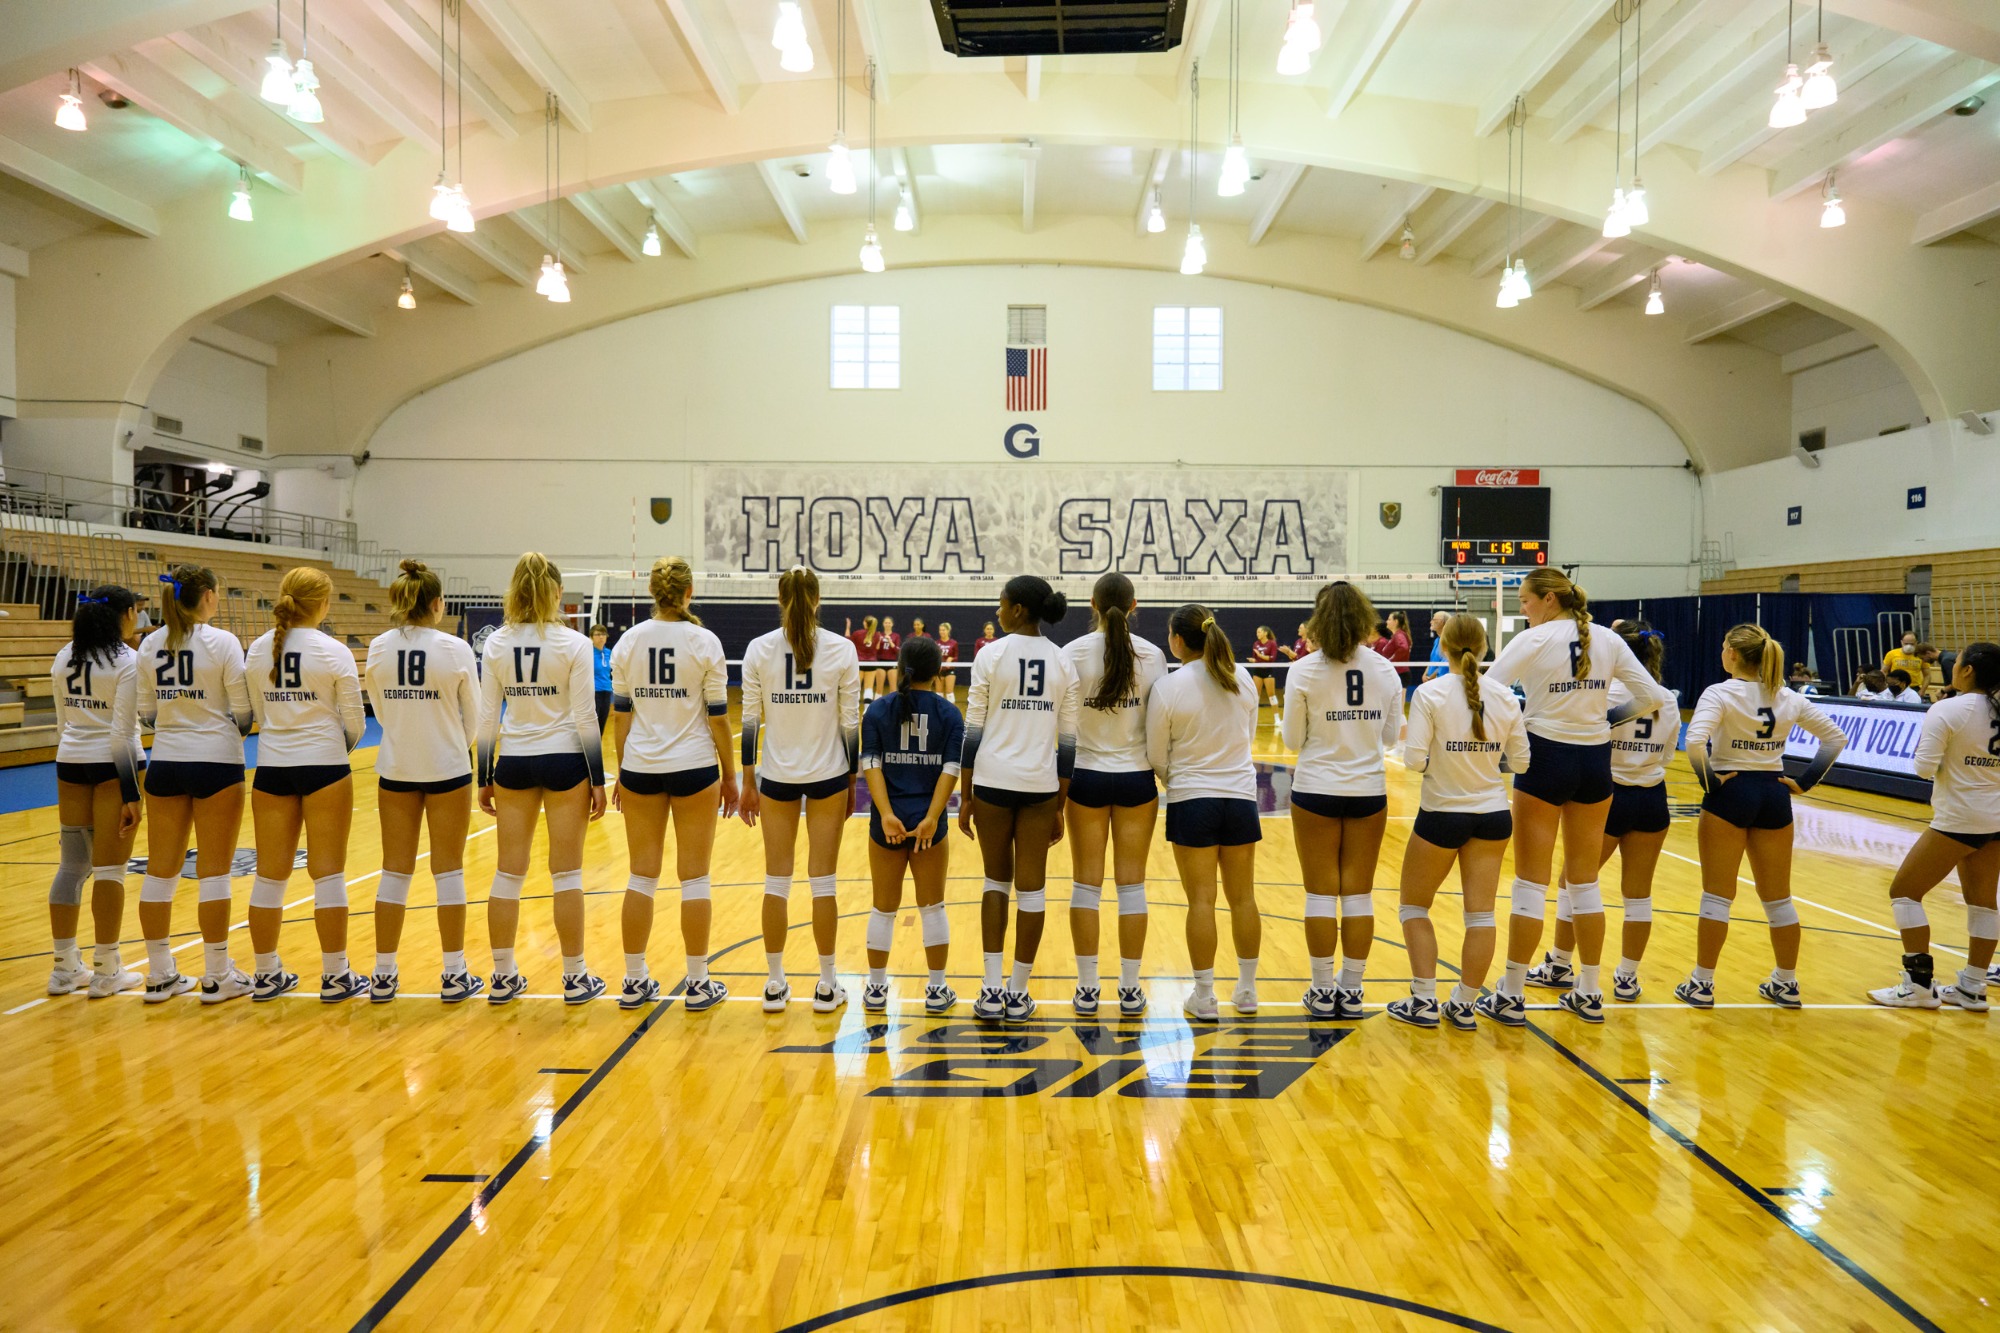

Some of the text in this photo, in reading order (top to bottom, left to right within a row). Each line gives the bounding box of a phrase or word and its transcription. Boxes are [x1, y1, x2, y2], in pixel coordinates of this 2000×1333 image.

[1004, 423, 1041, 459] G
[1911, 494, 1922, 503] 116
[1790, 512, 1799, 520] 117
[742, 496, 1314, 574] HOYA SAXA
[1490, 542, 1513, 554] 1:15
[1522, 542, 1540, 550] RIDER
[1458, 551, 1466, 564] 0
[1501, 556, 1506, 564] 1
[1537, 551, 1545, 564] 0
[156, 650, 194, 686] 20
[275, 652, 302, 688] 19
[398, 650, 426, 686] 18
[513, 647, 541, 683] 17
[649, 647, 675, 684] 16
[66, 658, 92, 696] 21
[1019, 658, 1045, 697] 13
[504, 686, 558, 697] GEORGETOWN
[634, 687, 688, 699] GEORGETOWN
[1346, 669, 1364, 706] 8
[1549, 680, 1606, 693] GEORGETOWN
[384, 689, 440, 700] GEORGETOWN
[772, 693, 827, 704] GEORGETOWN
[1326, 710, 1382, 721] GEORGETOWN
[1756, 707, 1776, 738] 3
[900, 713, 929, 751] 14
[1865, 719, 1921, 759] VOLL
[1446, 741, 1501, 752] GEORGETOWN
[885, 753, 942, 765] GEORGETOWN
[865, 1058, 1319, 1099] BIG
